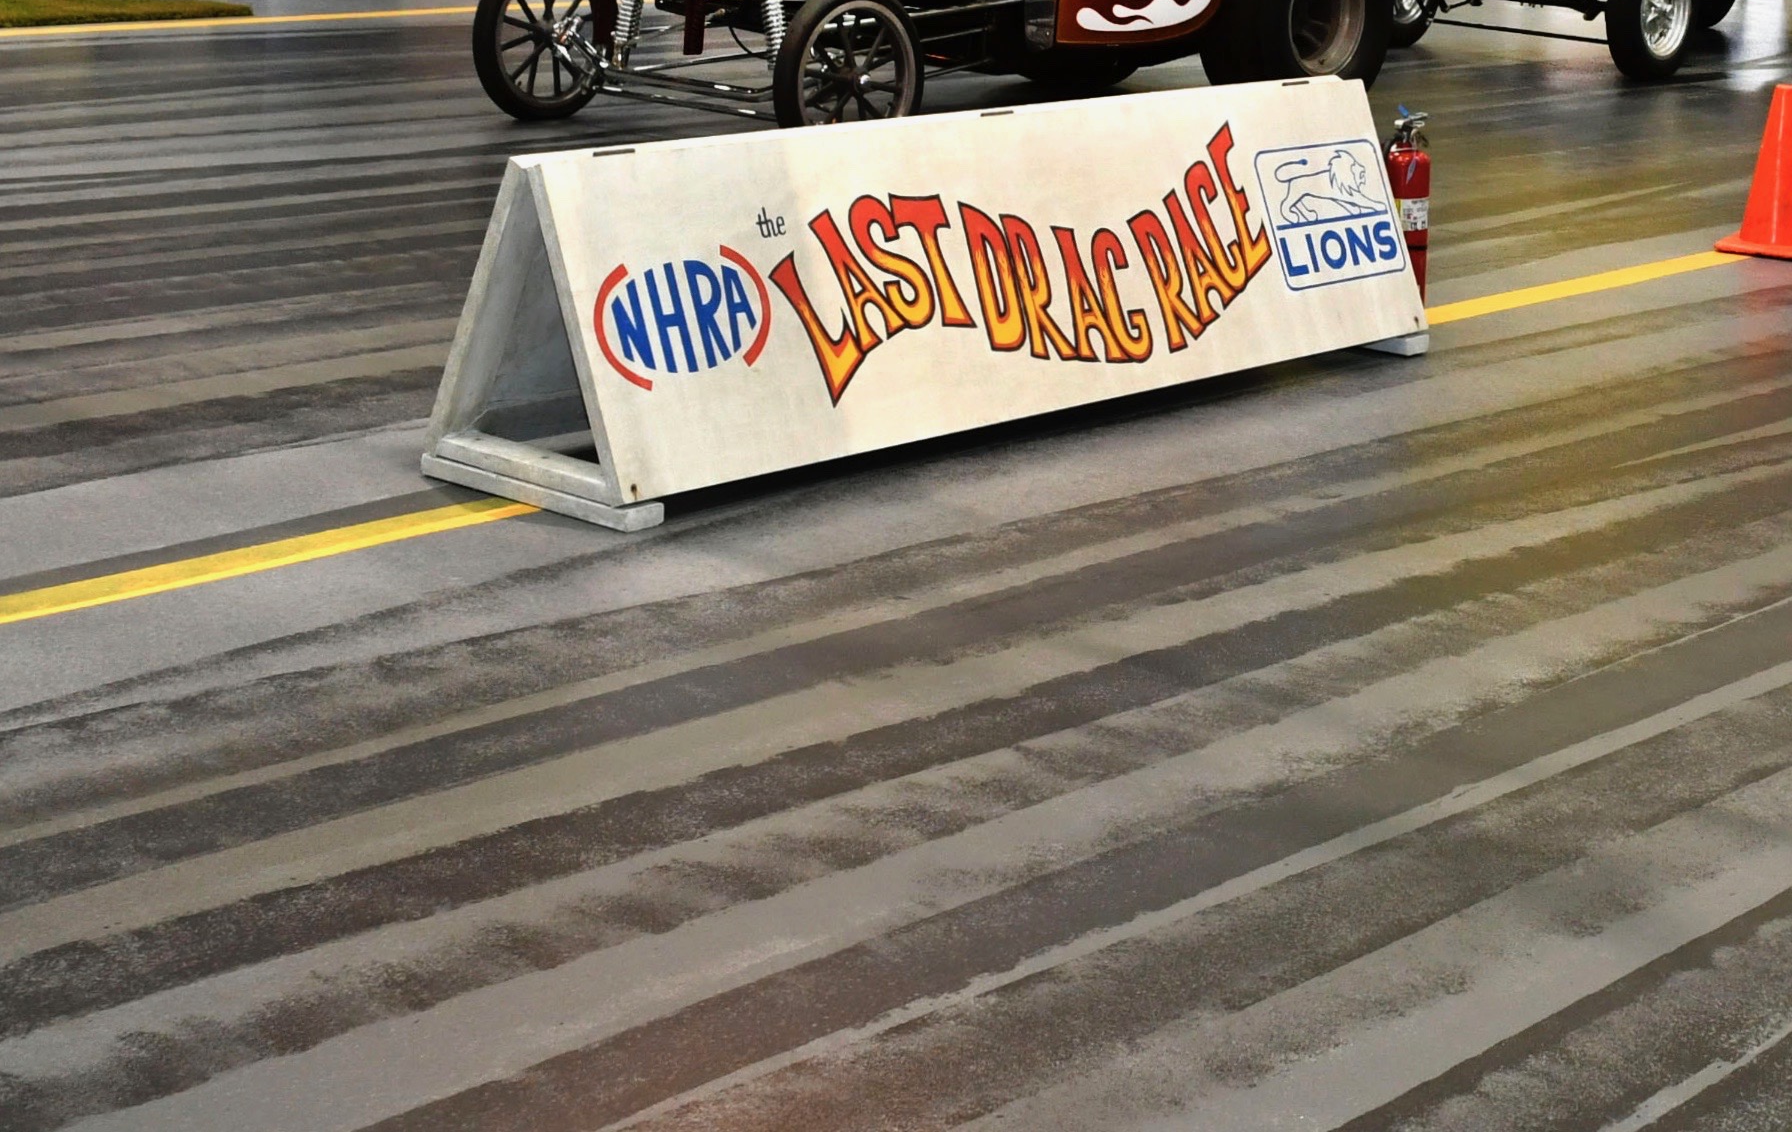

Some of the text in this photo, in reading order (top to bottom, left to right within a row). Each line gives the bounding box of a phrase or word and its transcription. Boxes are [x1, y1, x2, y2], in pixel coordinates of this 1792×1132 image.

[756, 120, 1273, 408] the LAST DRAG RACE
[1276, 220, 1399, 277] LIONS
[611, 259, 758, 374] NHRA
